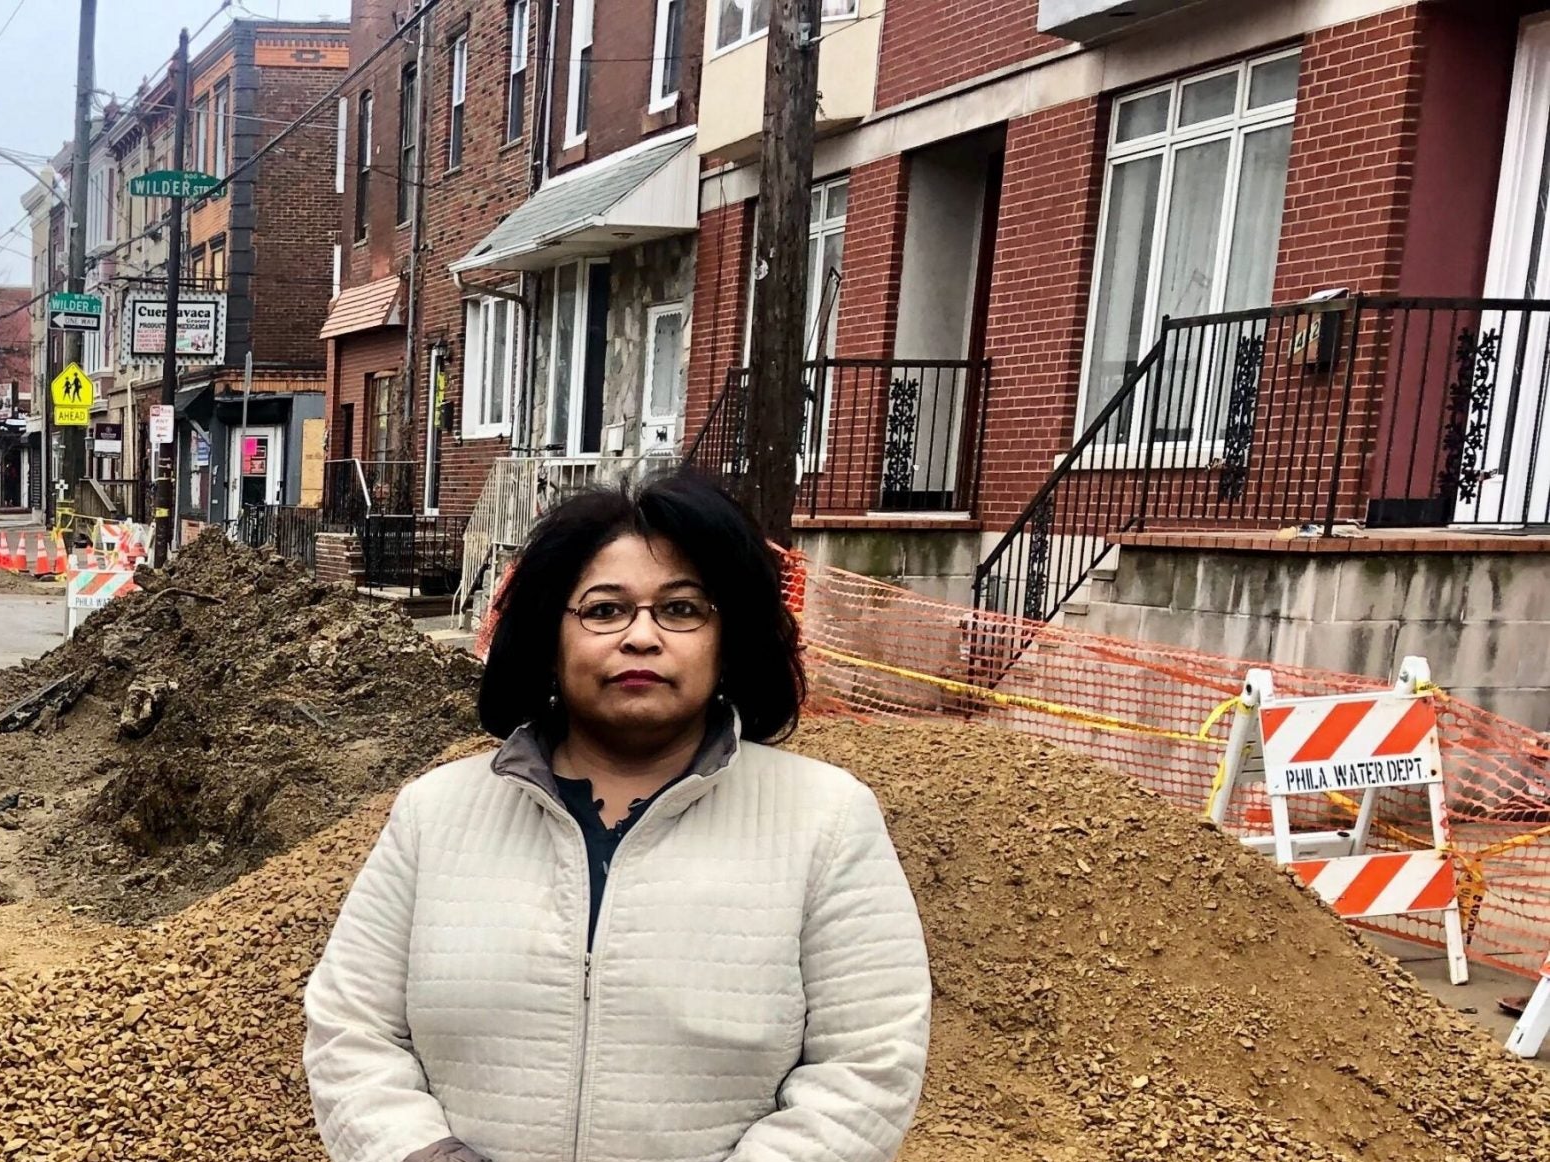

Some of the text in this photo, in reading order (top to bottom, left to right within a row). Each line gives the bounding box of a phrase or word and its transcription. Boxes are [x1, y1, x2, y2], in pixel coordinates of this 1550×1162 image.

[135, 179, 190, 196] WILDER
[52, 299, 101, 313] WILDER ST
[138, 306, 211, 318] Cueravaca
[65, 316, 95, 326] ONE WAY
[58, 410, 86, 421] AHEAD
[1333, 760, 1386, 787] WATER
